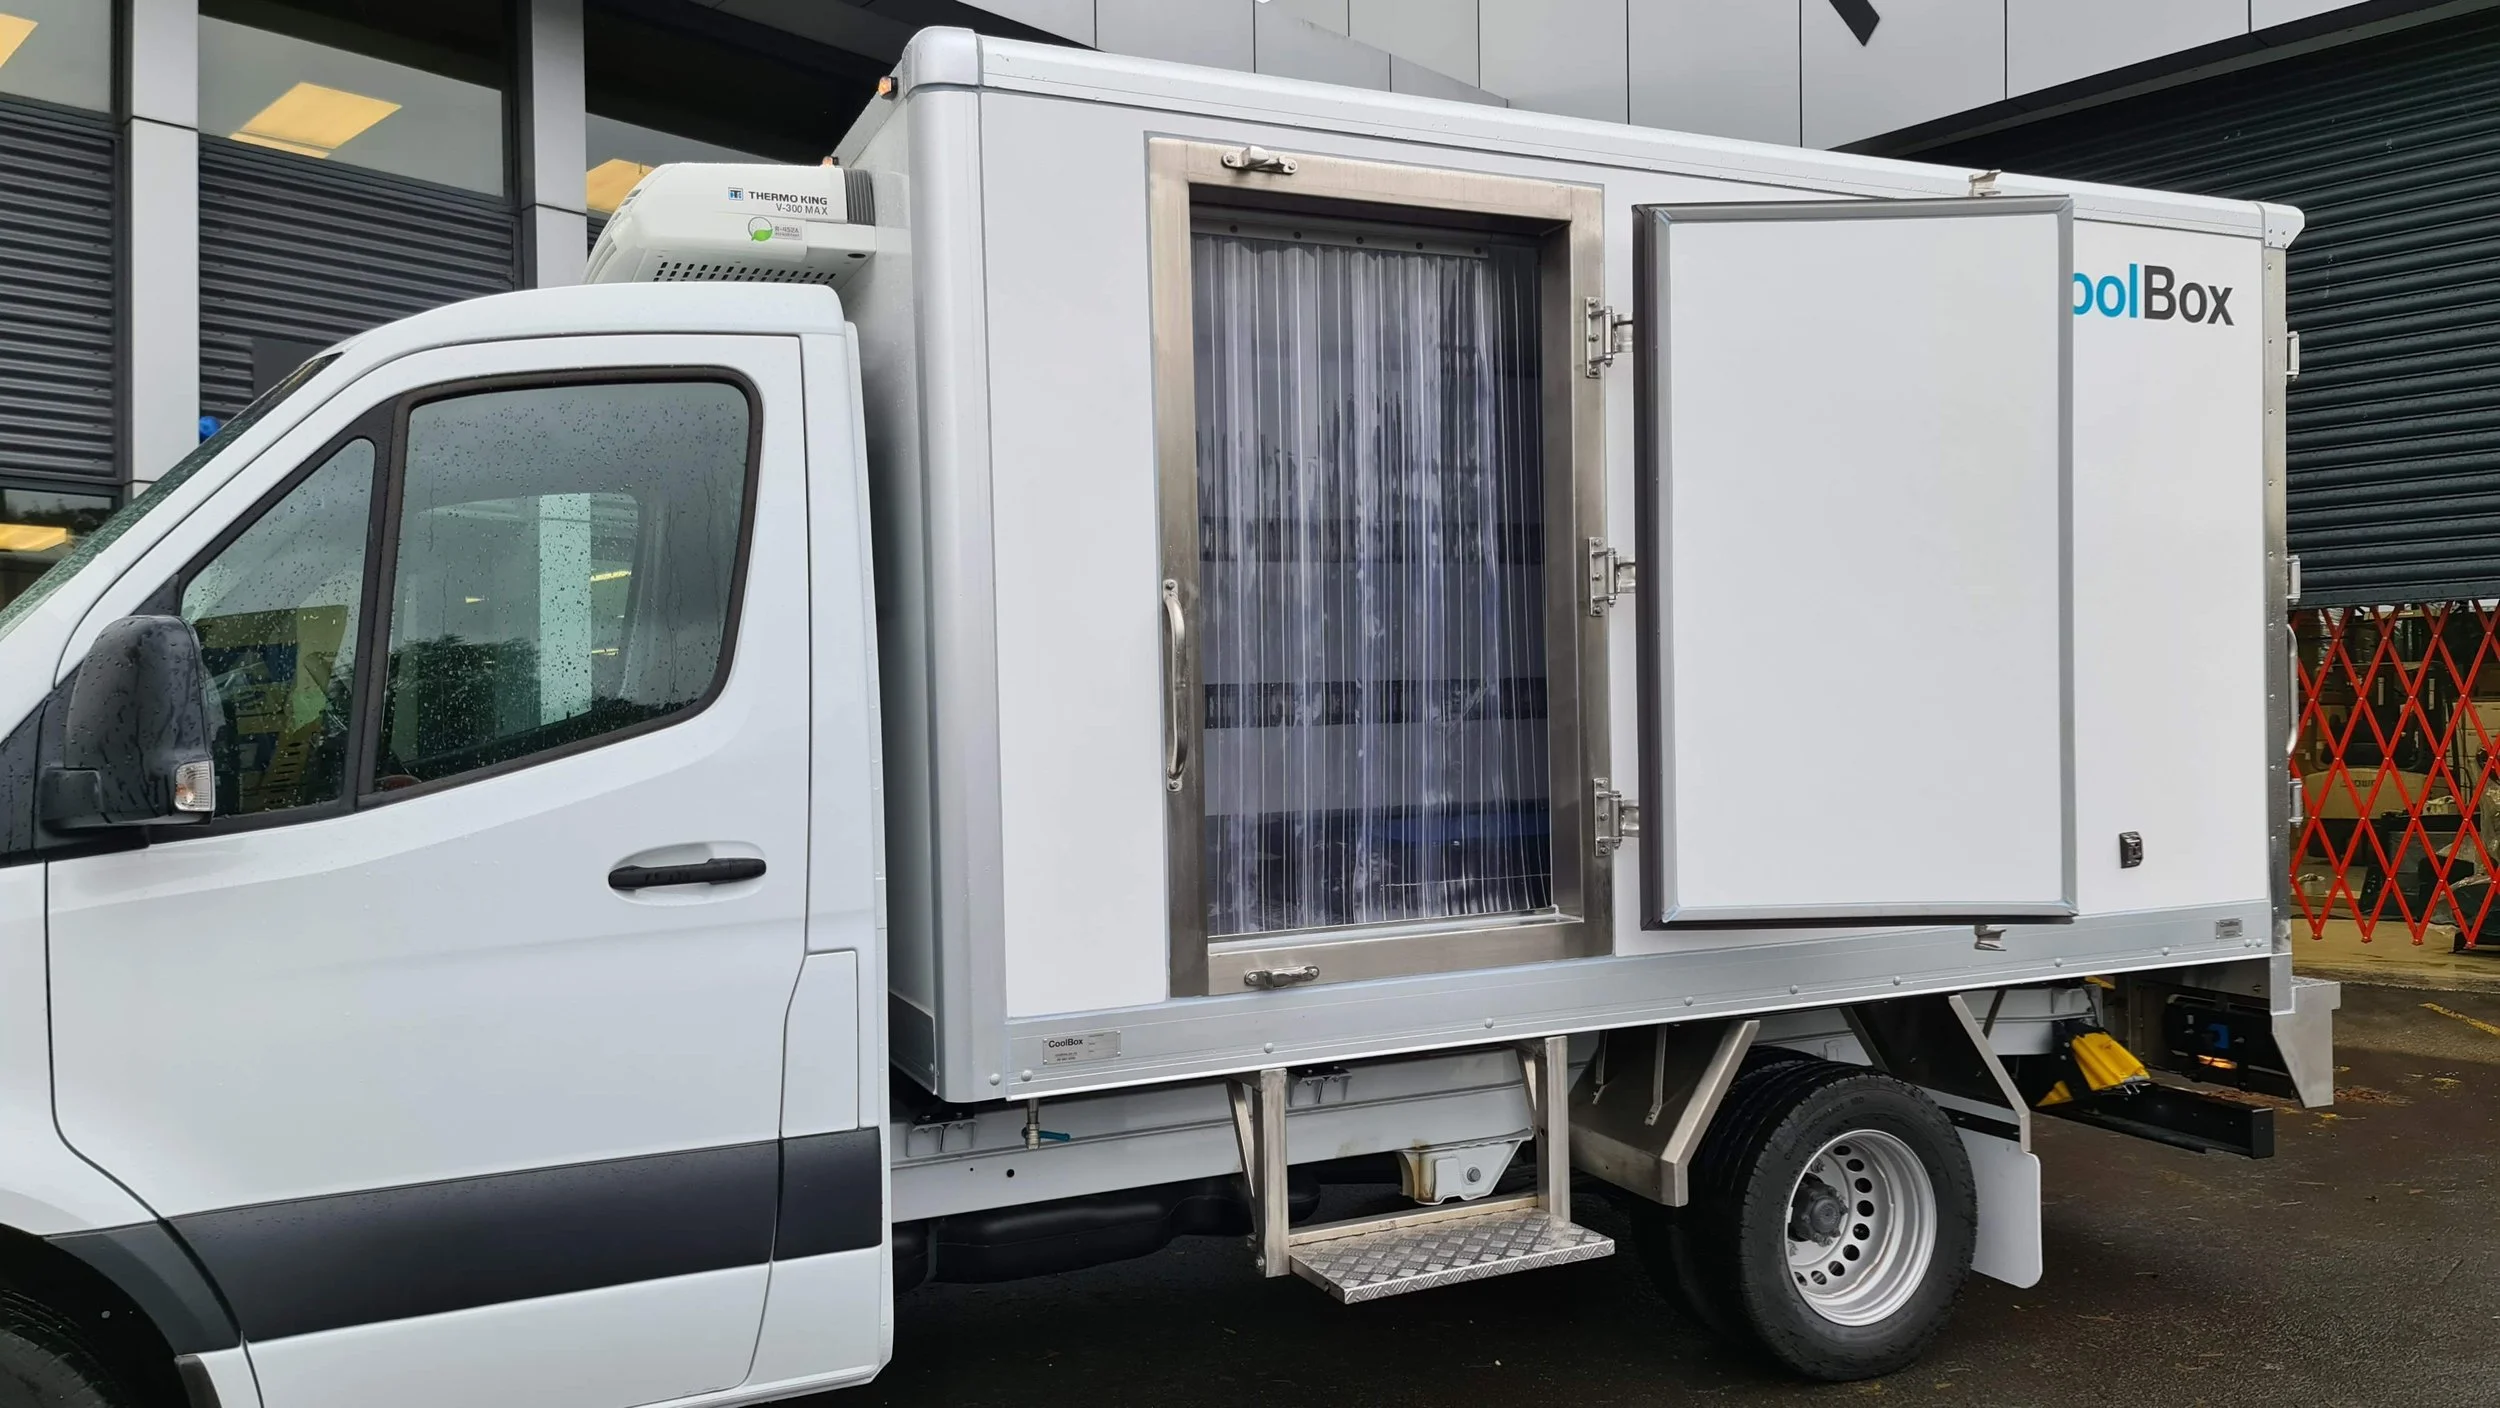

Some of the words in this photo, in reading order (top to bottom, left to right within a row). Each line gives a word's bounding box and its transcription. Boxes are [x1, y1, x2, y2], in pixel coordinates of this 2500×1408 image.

[748, 190, 798, 204] THERMO
[800, 195, 828, 206] KING
[775, 203, 802, 214] V-300
[804, 206, 828, 216] MAX
[2073, 263, 2235, 326] oolBox
[1048, 1038, 1084, 1049] CoolBox
